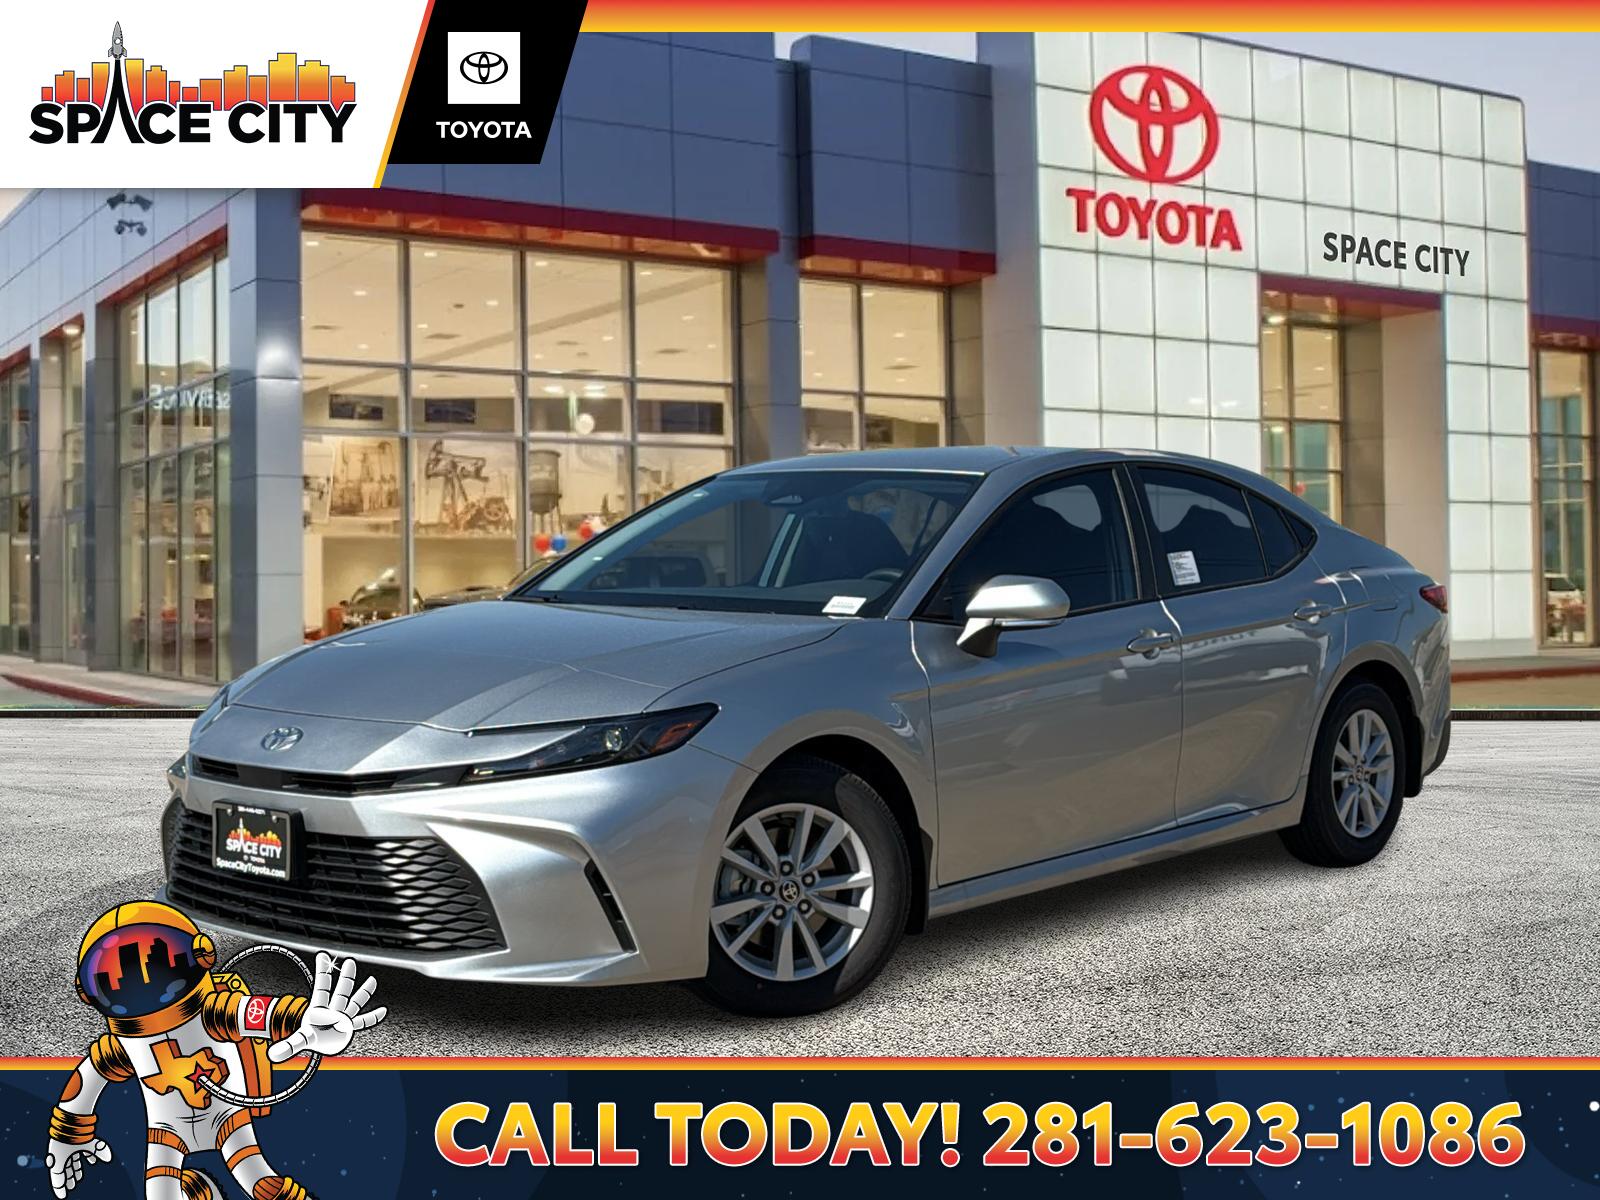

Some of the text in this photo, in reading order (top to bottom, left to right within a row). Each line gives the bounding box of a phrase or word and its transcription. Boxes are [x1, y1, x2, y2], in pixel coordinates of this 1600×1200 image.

[1065, 187, 1243, 252] TOYOTA
[1322, 231, 1470, 277] SPACE CITY
[225, 838, 282, 859] SPACE CITY
[216, 857, 286, 878] SpaceCityToyota.com
